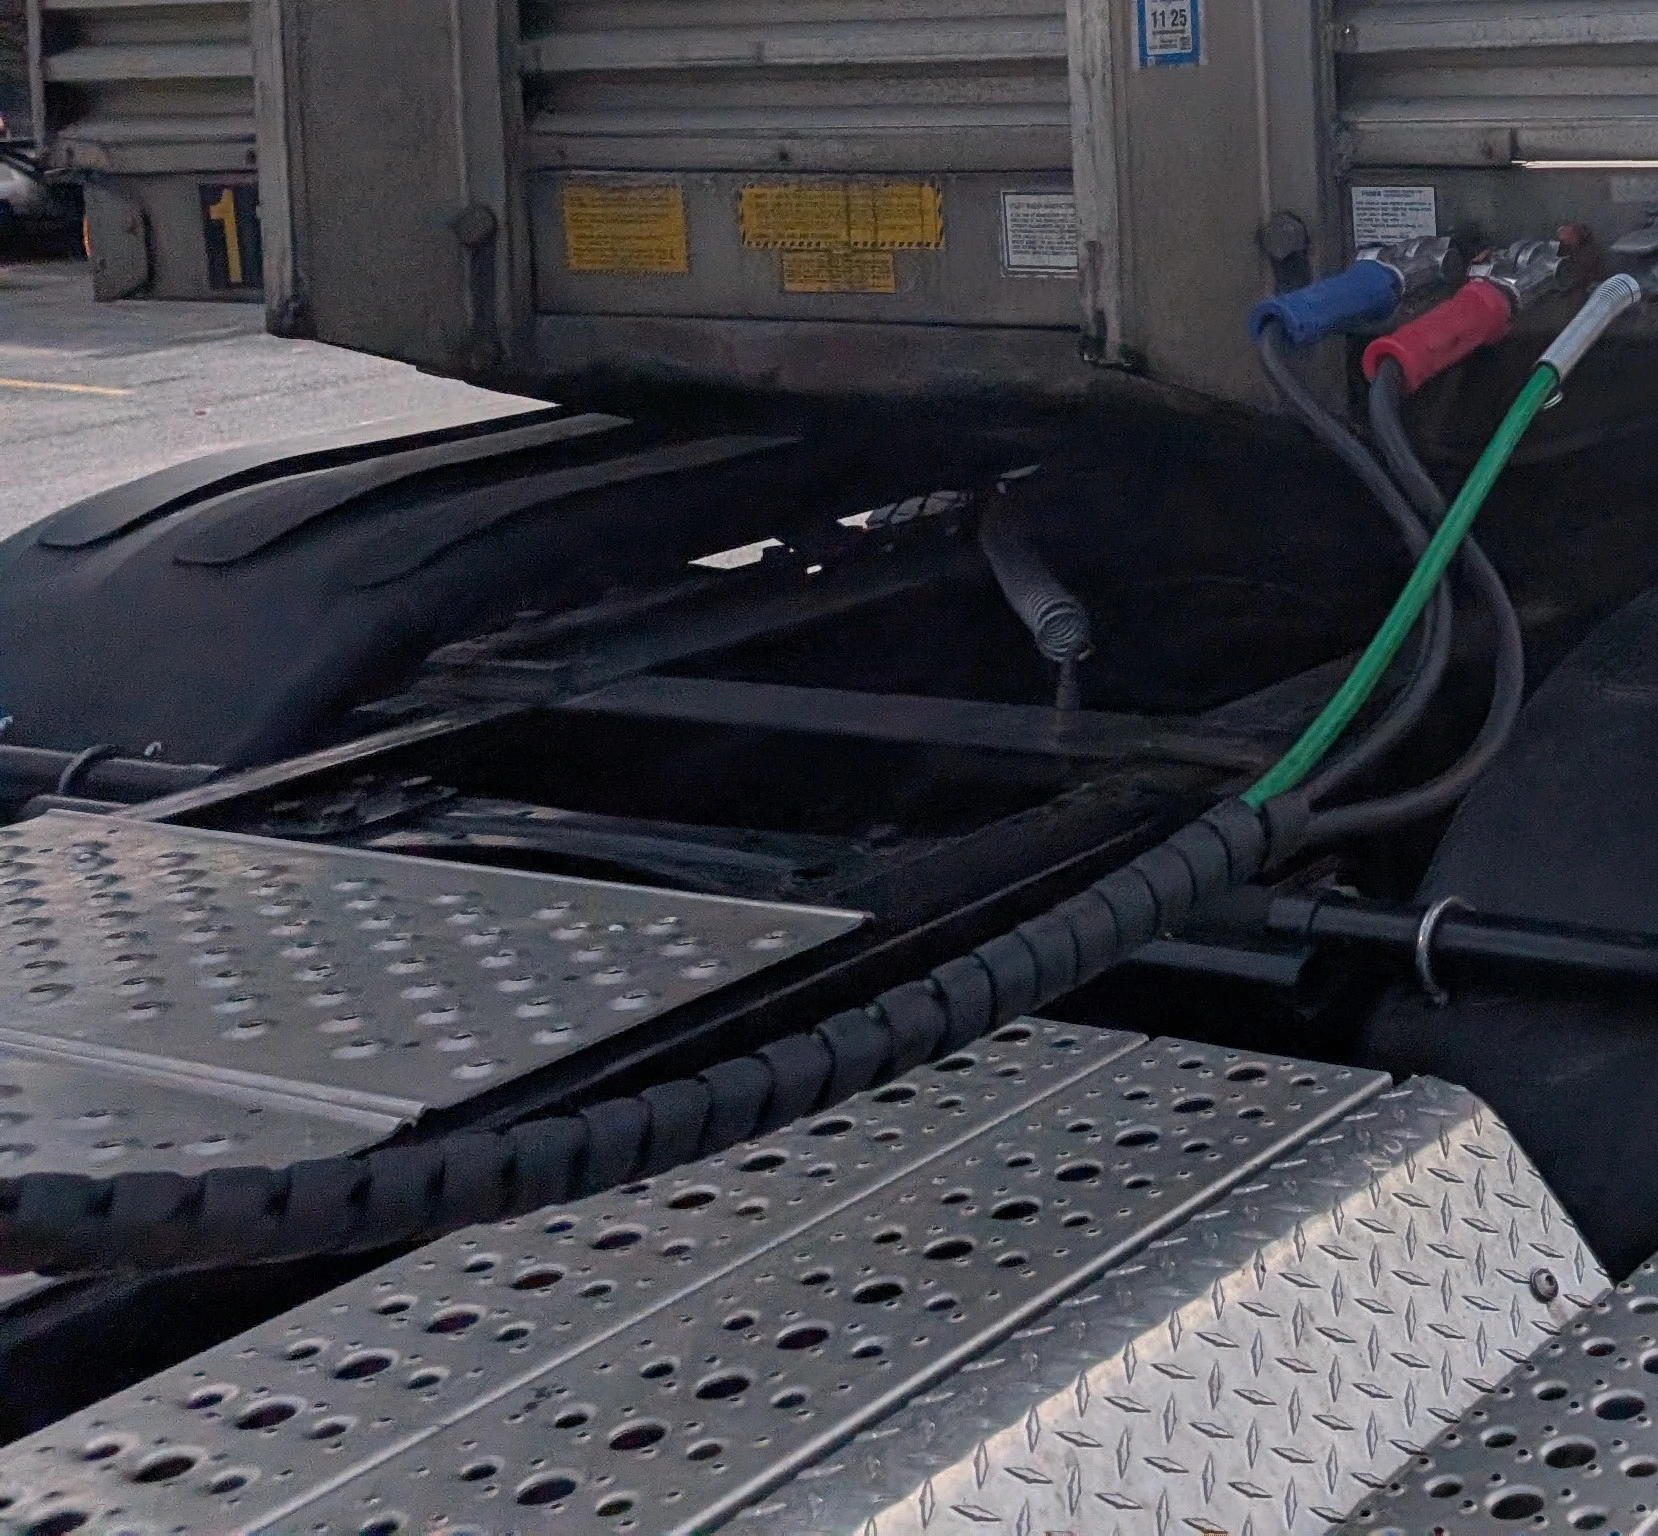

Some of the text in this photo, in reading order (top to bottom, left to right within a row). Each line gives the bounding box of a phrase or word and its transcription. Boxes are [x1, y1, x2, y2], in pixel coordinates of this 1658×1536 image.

[1151, 7, 1187, 28] 11 25
[208, 188, 243, 284] 1
